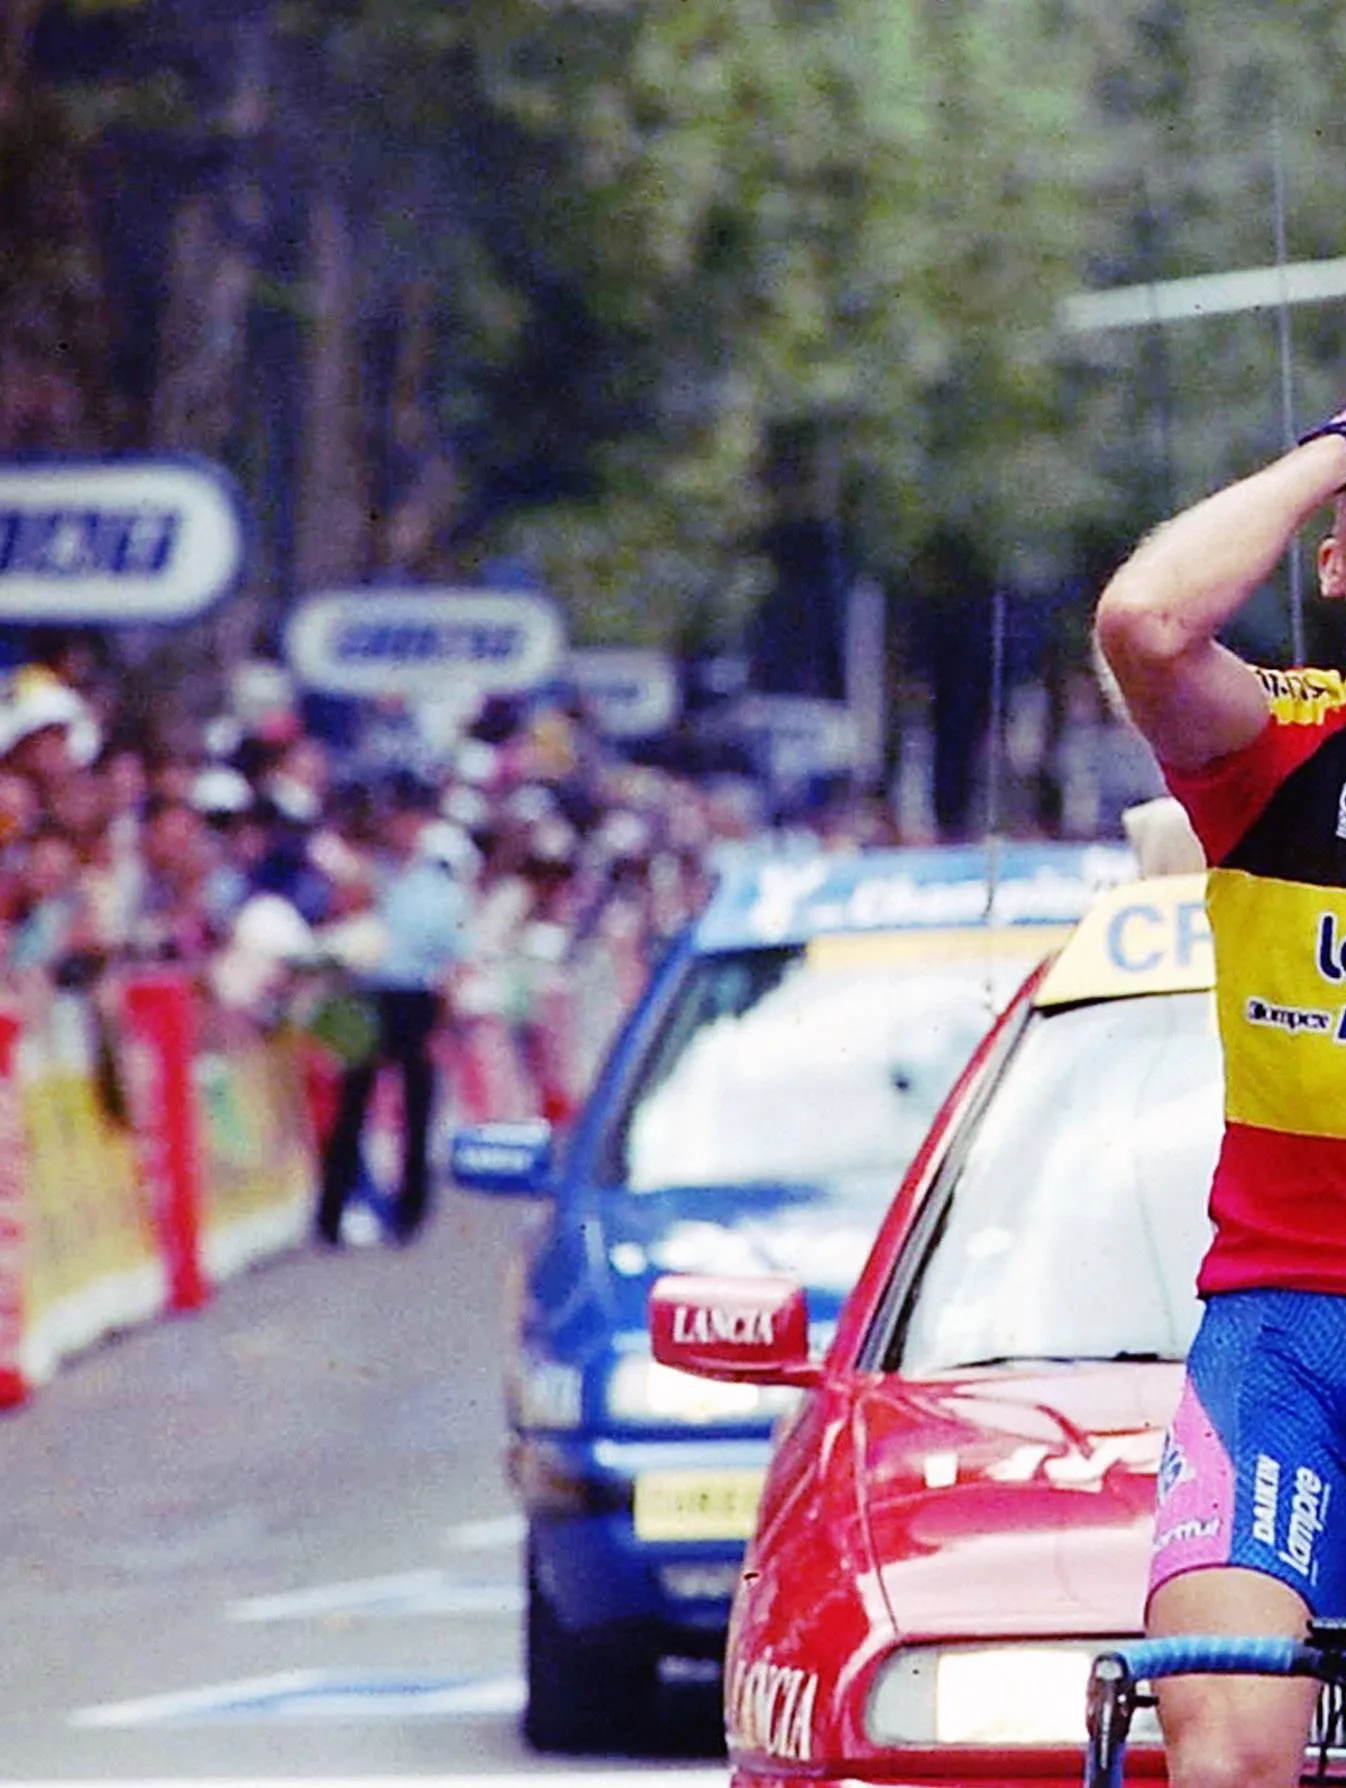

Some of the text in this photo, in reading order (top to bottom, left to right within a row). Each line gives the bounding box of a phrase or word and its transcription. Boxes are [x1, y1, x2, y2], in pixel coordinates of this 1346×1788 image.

[673, 1304, 775, 1346] LANCIA
[1252, 1453, 1281, 1547] DAIKIN
[1278, 1466, 1323, 1577] lampre
